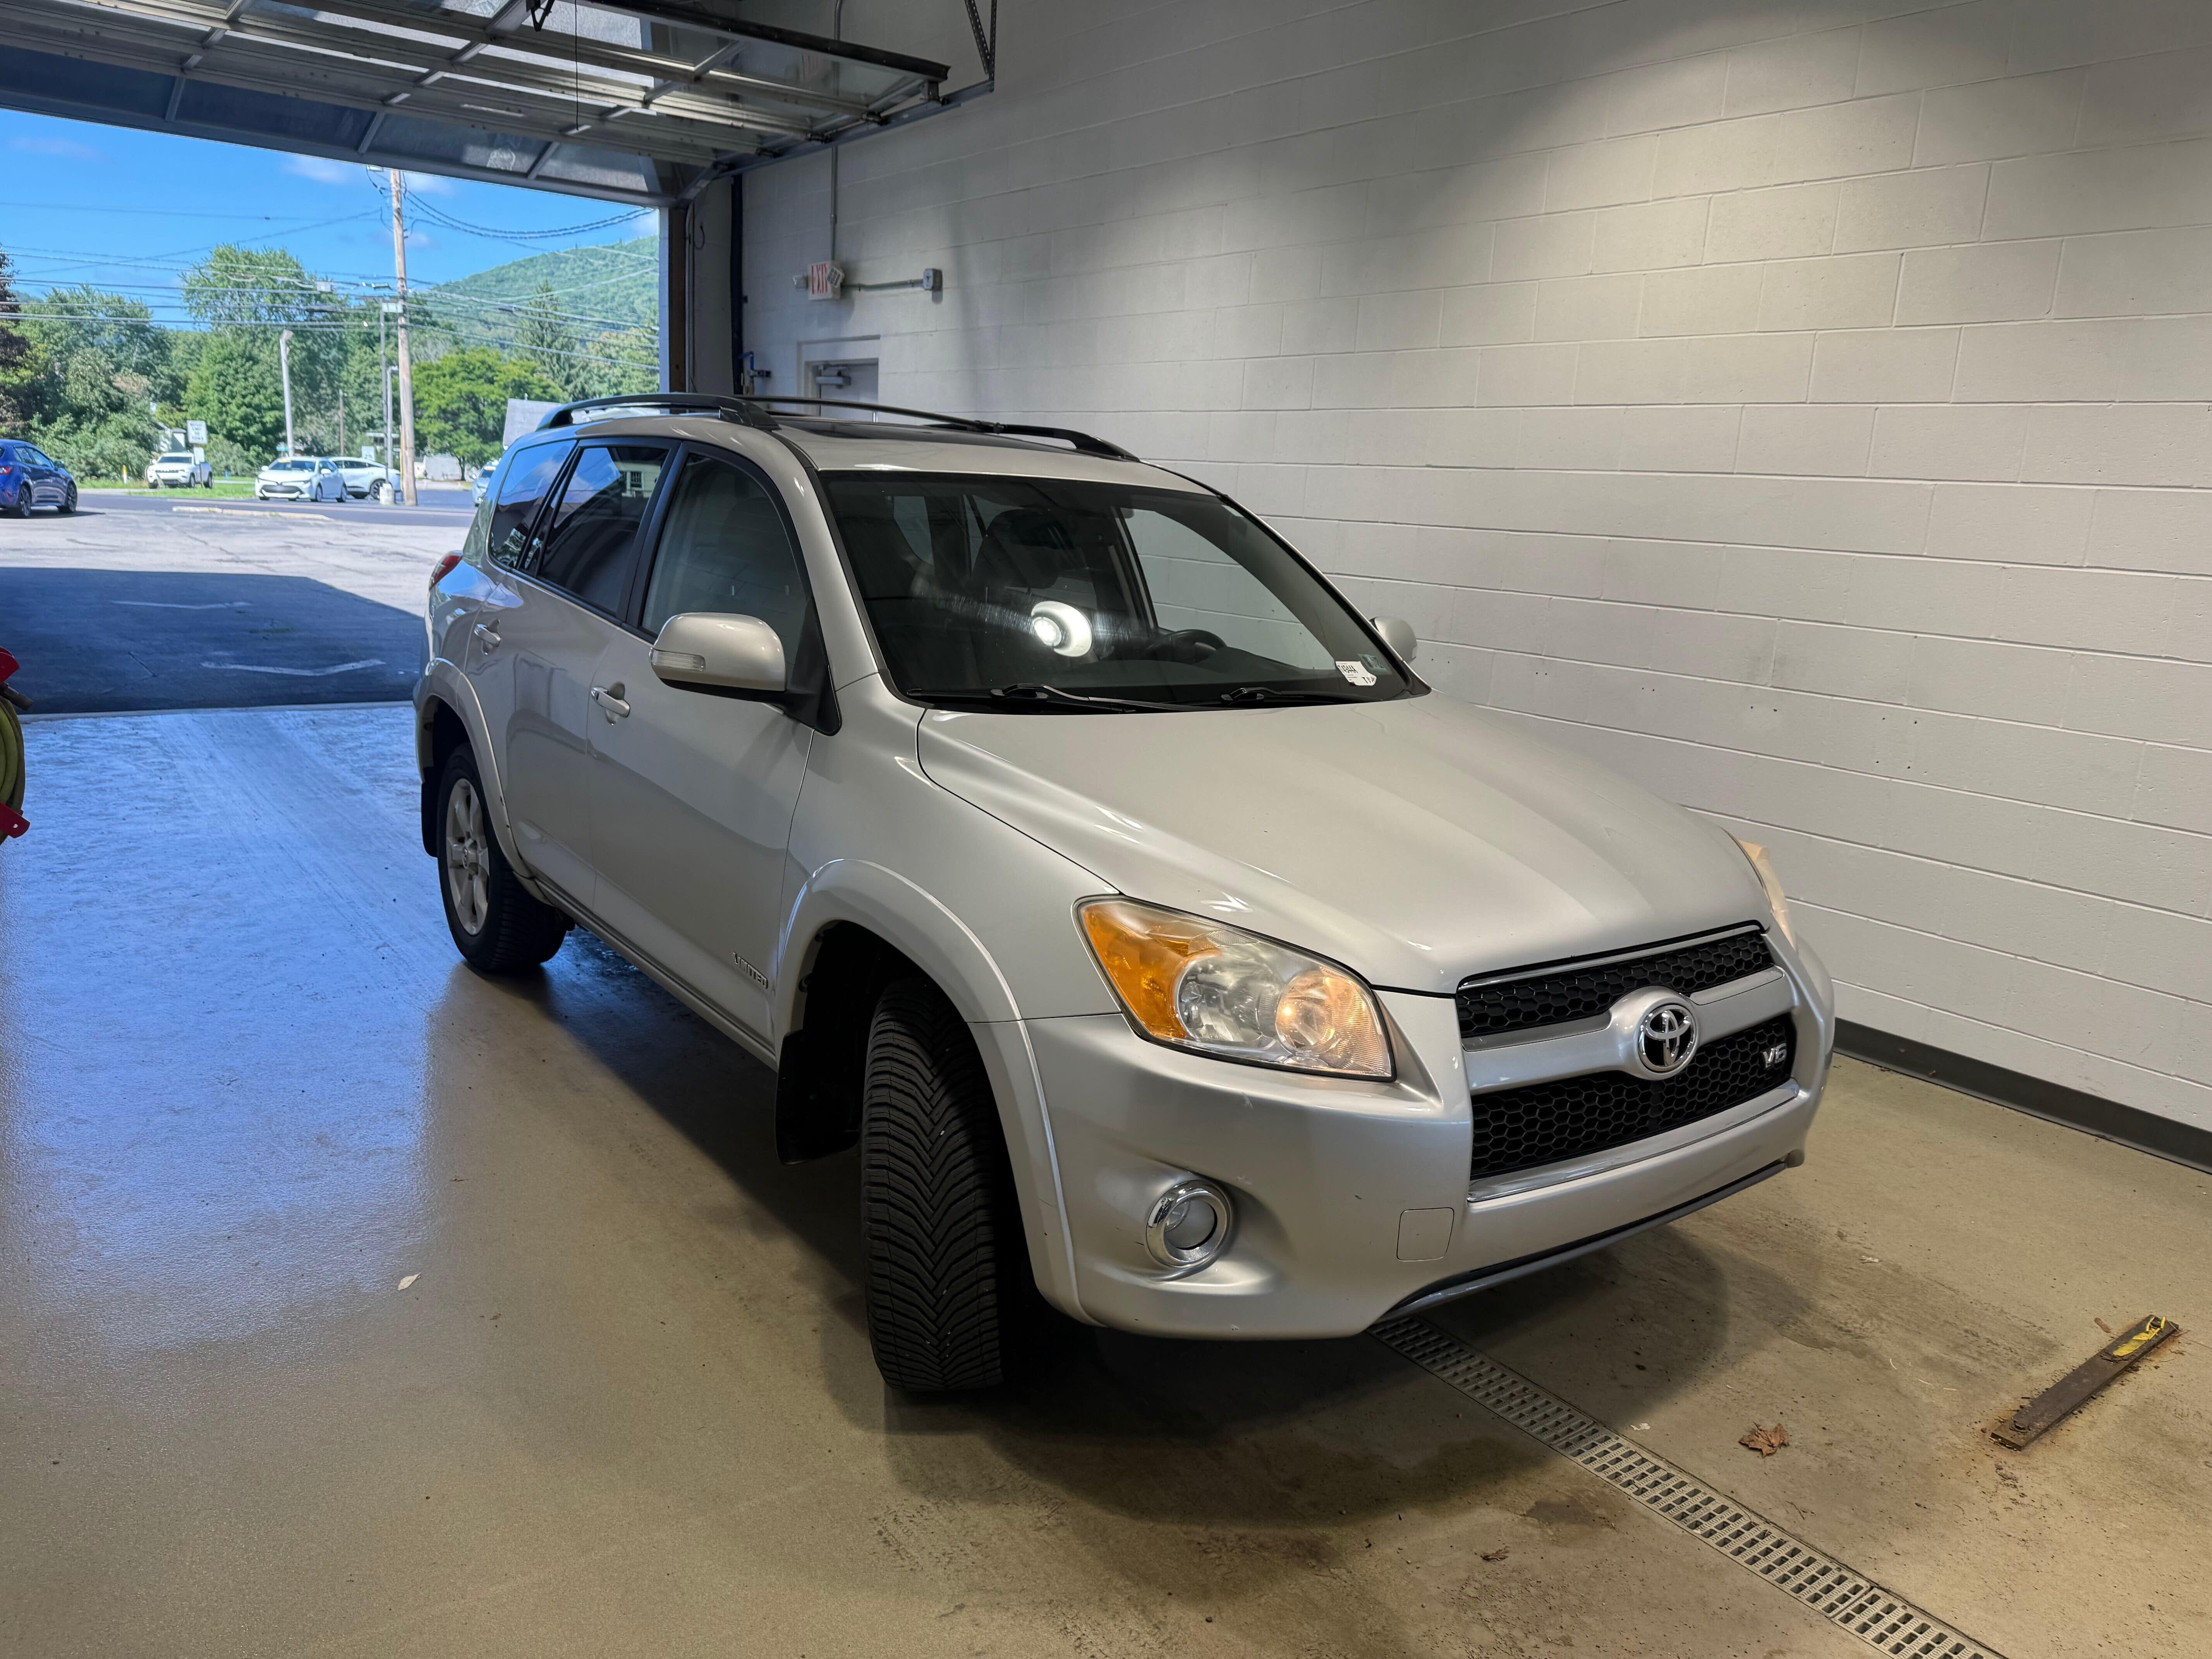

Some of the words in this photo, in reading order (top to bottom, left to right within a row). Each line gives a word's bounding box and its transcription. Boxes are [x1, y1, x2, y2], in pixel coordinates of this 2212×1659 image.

[812, 263, 828, 294] EXIT
[732, 951, 768, 989] LIMITED
[1762, 1043, 1787, 1069] V6
